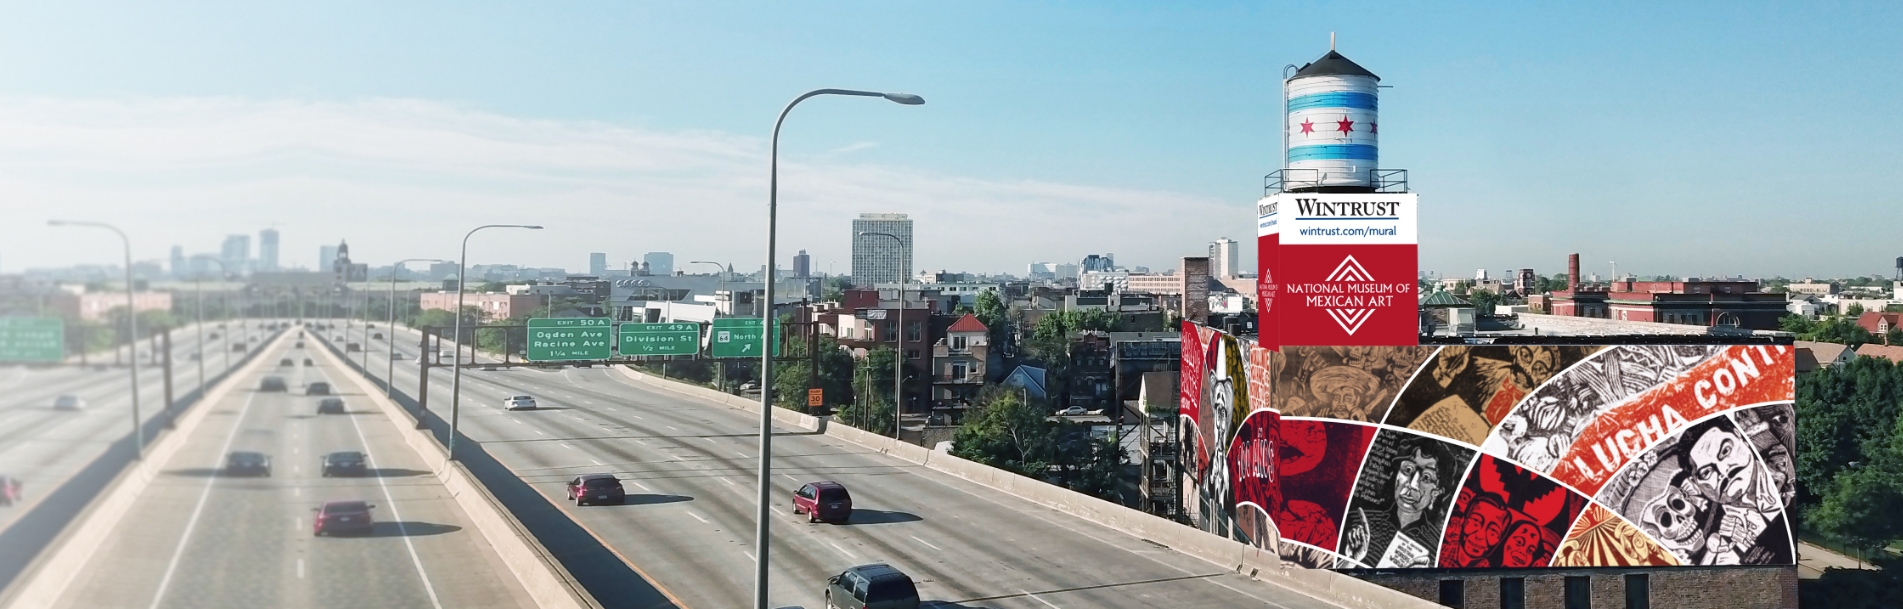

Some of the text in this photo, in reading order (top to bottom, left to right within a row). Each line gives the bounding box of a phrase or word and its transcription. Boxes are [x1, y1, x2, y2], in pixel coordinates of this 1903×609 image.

[1295, 198, 1400, 217] WINTRUST
[1300, 225, 1397, 238] wintrust.com/mural
[1286, 283, 1343, 294] NATIONAL
[1347, 283, 1393, 294] MUSEUM
[1395, 283, 1411, 294] OF
[1306, 295, 1394, 307] MEXICAN ART
[536, 331, 574, 340] Ogden
[625, 335, 674, 343] Division
[534, 340, 576, 348] Racine
[1573, 404, 1690, 482] LUCHA
